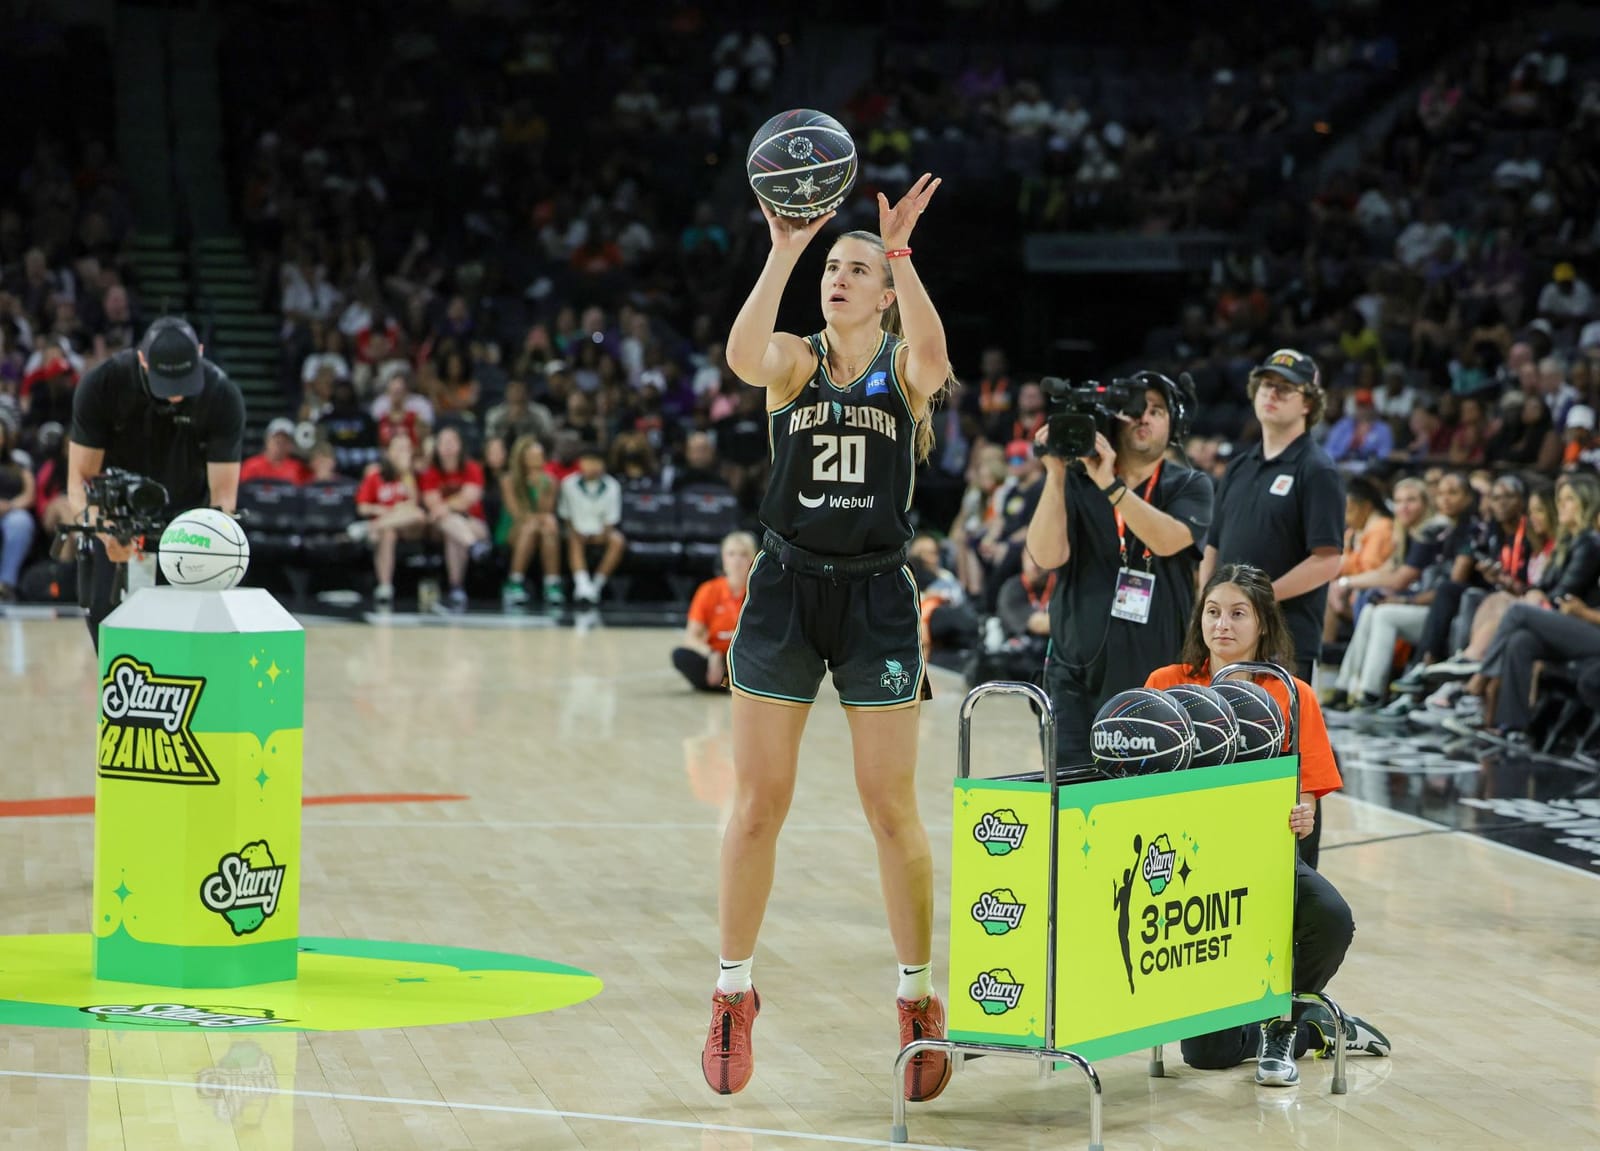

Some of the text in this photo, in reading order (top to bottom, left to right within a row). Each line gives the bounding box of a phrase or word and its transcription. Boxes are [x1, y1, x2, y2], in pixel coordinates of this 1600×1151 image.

[788, 401, 897, 442] NEW YORK
[812, 434, 866, 484] 20
[829, 495, 875, 509] Webull
[102, 665, 191, 733] Starry
[100, 724, 201, 774] RANGE
[1094, 729, 1158, 751] Wilson
[974, 814, 1026, 850] Starry
[1143, 843, 1176, 883] Starry
[203, 855, 284, 916] Starry
[972, 893, 1024, 929] Starry
[1164, 887, 1248, 940] POINT
[1140, 934, 1232, 975] CONTEST
[970, 973, 1022, 1009] Starry
